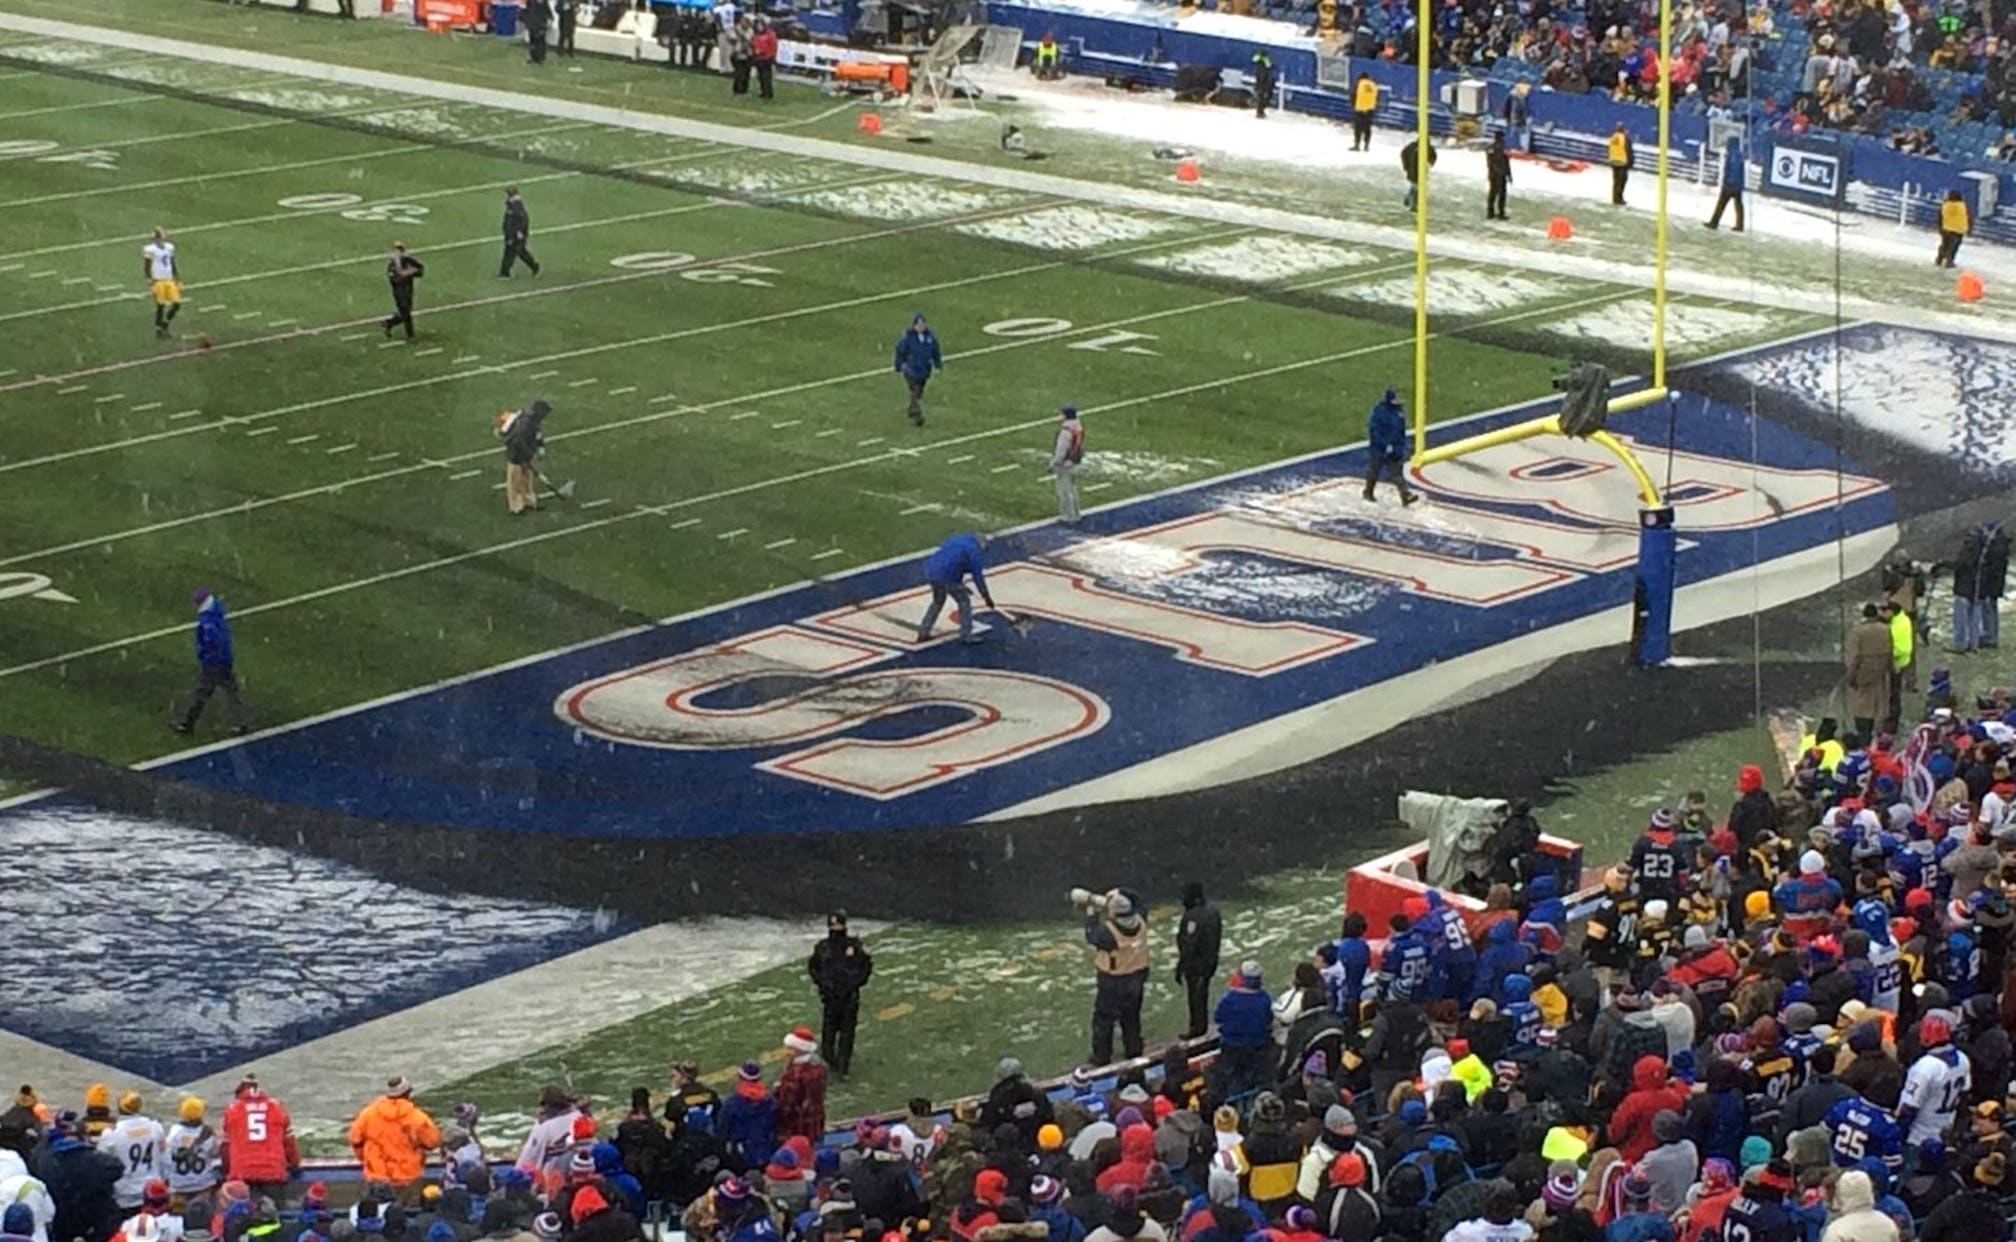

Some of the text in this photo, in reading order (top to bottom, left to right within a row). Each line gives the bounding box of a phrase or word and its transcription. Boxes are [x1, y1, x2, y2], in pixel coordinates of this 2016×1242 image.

[1801, 162, 1832, 184] NFL
[982, 318, 1163, 357] 10
[1643, 853, 1675, 878] 23
[1919, 864, 1938, 888] 12
[247, 1112, 267, 1141] 5
[1833, 1122, 1867, 1161] 25
[129, 1141, 154, 1172] 94
